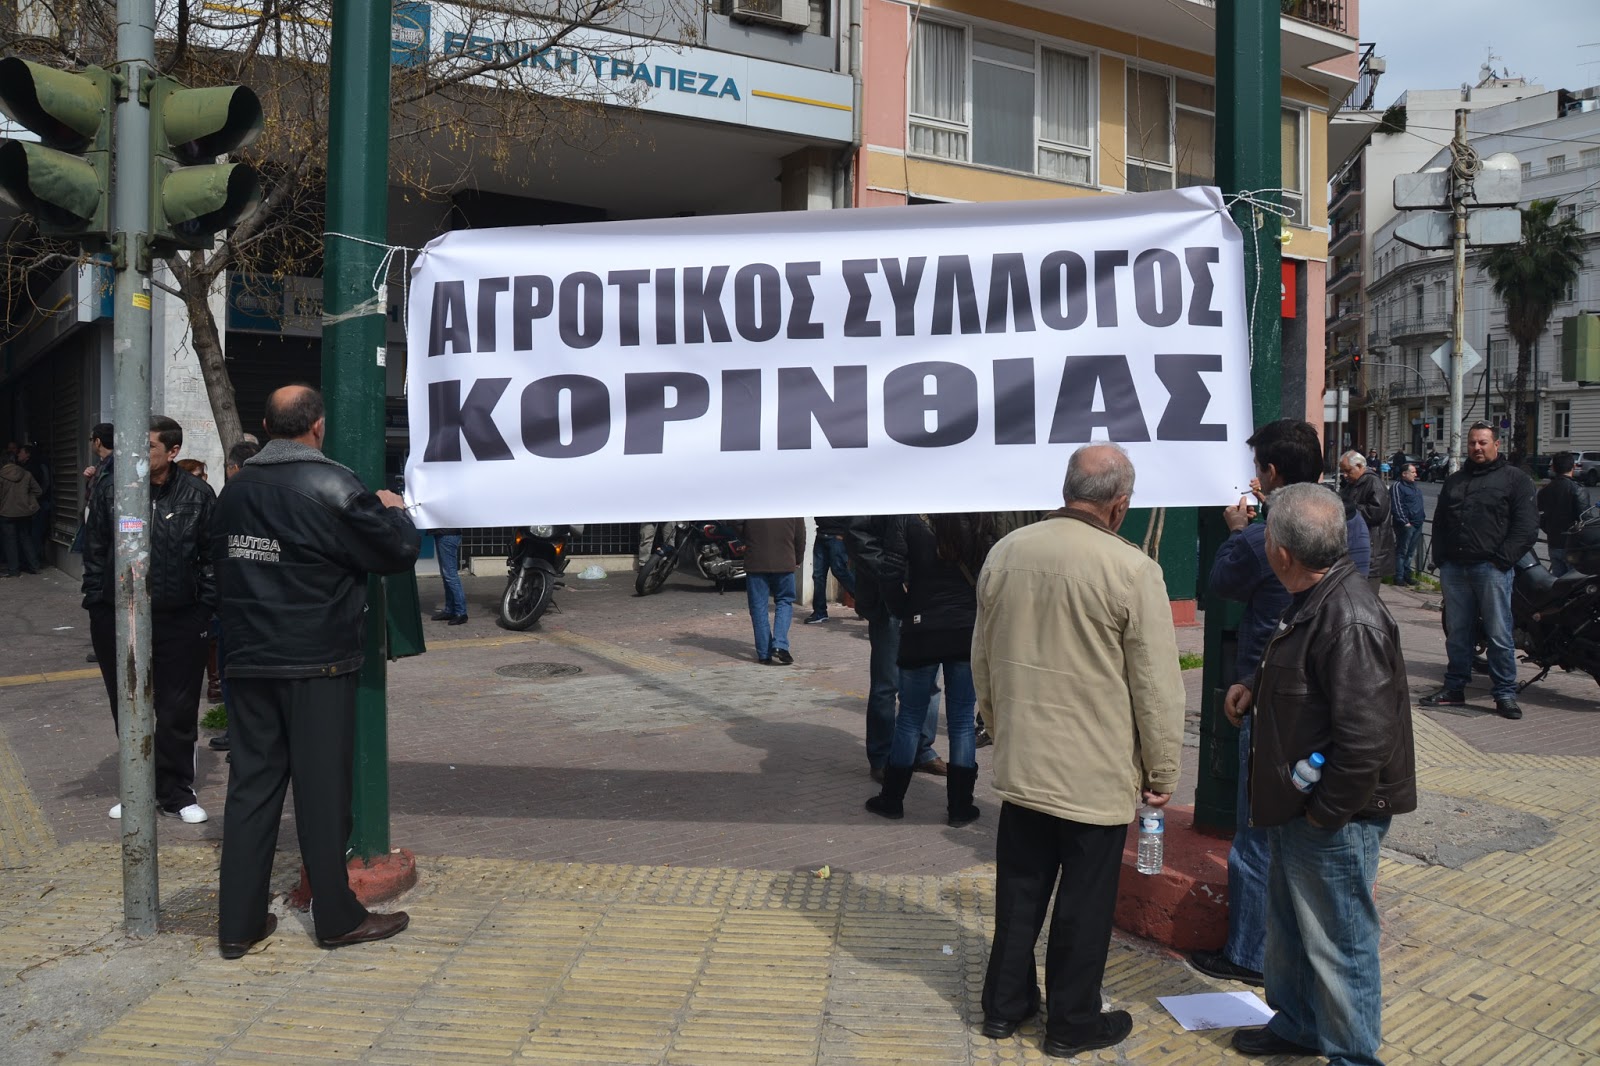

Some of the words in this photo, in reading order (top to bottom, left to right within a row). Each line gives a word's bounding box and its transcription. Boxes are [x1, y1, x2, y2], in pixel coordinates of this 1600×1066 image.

[591, 54, 742, 101] ΤΡΑΠΕΖΑ
[428, 261, 825, 358] ΑΓΡΟΤΙΚΟΣ
[841, 247, 1223, 338] ΣΥΛΛΟΓΟΣ
[423, 354, 1228, 463] ΚΟΡΙΝΘΙΑΣ
